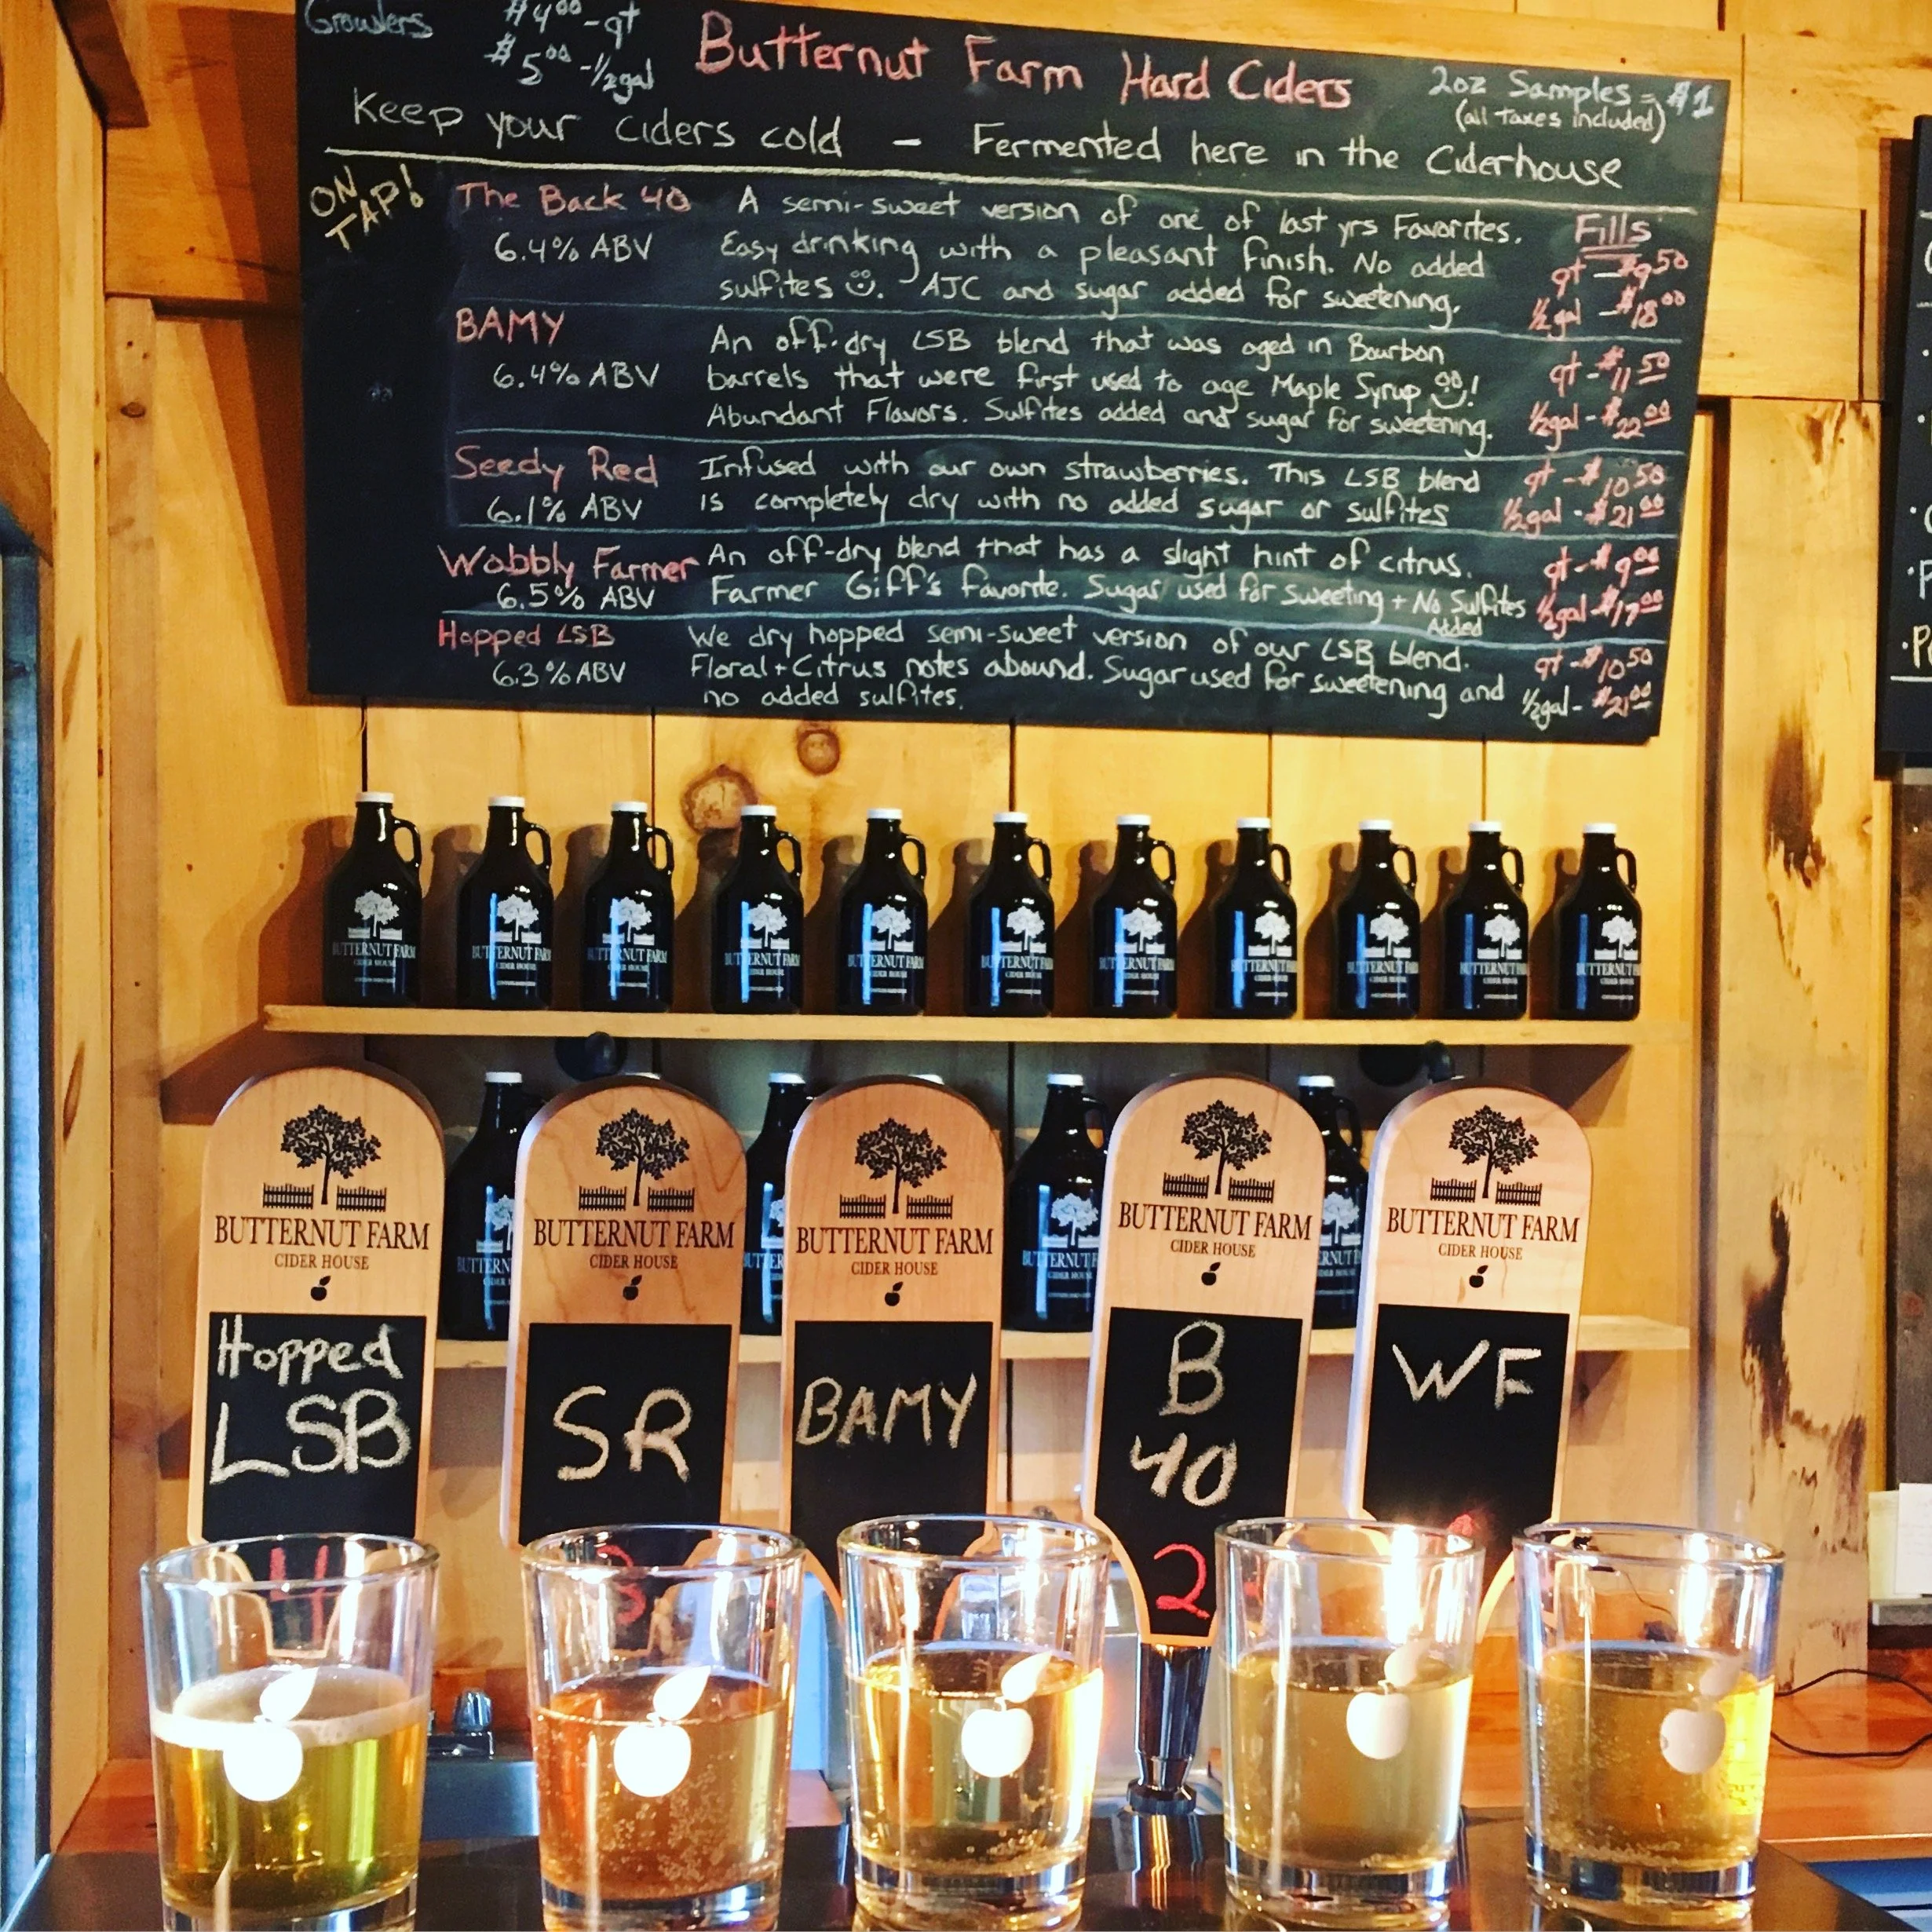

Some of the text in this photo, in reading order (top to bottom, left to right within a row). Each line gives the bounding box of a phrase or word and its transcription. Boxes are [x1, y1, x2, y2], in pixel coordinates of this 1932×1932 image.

[305, 0, 433, 38] Growlers
[696, 11, 1352, 108] Butternut Farm Hard Ciders
[1429, 66, 1485, 95] 2oz
[1510, 70, 1631, 114] Samples
[354, 88, 463, 136] Keep
[487, 111, 576, 149] your
[761, 116, 842, 157] cold
[974, 121, 1161, 162] Fermented
[1192, 130, 1268, 164] here
[1296, 148, 1324, 166] in
[1339, 135, 1398, 169] the
[1426, 141, 1622, 188] Ciderhouse
[1455, 99, 1488, 132] (all
[1573, 93, 1666, 144] included)
[311, 166, 357, 217] ON
[321, 163, 423, 250] TAP!
[457, 182, 691, 215] The Back 40
[739, 185, 758, 214] A
[982, 203, 1079, 223] version
[1101, 194, 1138, 225] of
[1160, 214, 1203, 230] one
[1225, 200, 1260, 231] of
[1280, 207, 1328, 234] last
[1339, 220, 1378, 247] yrs
[1394, 210, 1521, 243] Favorites.
[1576, 213, 1651, 244] Fills
[495, 232, 652, 262] 6.4% ABV
[721, 231, 777, 264] Easy
[793, 228, 919, 283] drinking
[940, 234, 1011, 261] with
[1038, 245, 1057, 258] a
[1080, 234, 1218, 275] pleasant
[1354, 250, 1391, 274] No
[1411, 250, 1485, 278] added
[456, 307, 564, 344] BAMY
[710, 325, 752, 354] An
[913, 328, 971, 351] LSB
[997, 327, 1069, 355] blend
[1091, 326, 1153, 352] that
[1168, 337, 1221, 354] was
[1242, 333, 1295, 371] aged
[1309, 338, 1331, 355] in
[1349, 333, 1444, 364] Bourbon
[494, 362, 659, 389] 6.4% ABV
[707, 363, 809, 390] barrels
[835, 360, 904, 389] that
[919, 367, 994, 388] were
[1092, 366, 1141, 391] used
[1155, 369, 1182, 392] to
[1198, 380, 1254, 418] age
[1272, 374, 1341, 409] Maple
[1355, 372, 1421, 414] Syrup
[451, 446, 658, 492] Seedy Red
[699, 446, 1479, 493] Infused with our own strawberries. This LSB blend
[488, 492, 641, 528] 6.1% ABV
[701, 484, 1448, 535] is completely dry with no added sugar or sulfites
[438, 542, 699, 589] Wobbly Farmer
[708, 534, 1470, 579] An off-dry blend that has a slight hint of citrus.
[497, 583, 655, 609] 6.5% ABV
[439, 619, 615, 656] Hopped LSB
[688, 615, 1468, 672] We dry hopped semi-sweet version of our LSB blend.
[493, 661, 625, 687] 6.3% ABV
[214, 1215, 430, 1250] BUTTERNUT FARM
[533, 1218, 735, 1249] BUTTERNUT FARM
[796, 1226, 993, 1255] BUTTERNUT FARM
[1118, 1201, 1312, 1241] BUTTERNUT FARM
[1386, 1207, 1580, 1244] BUTTERNUT FARM
[274, 1253, 369, 1270] CIDER HOUSE
[590, 1255, 678, 1269] CIDER HOUSE
[851, 1262, 938, 1276] CIDER HOUSE
[1170, 1239, 1255, 1258] CIDER HOUSE
[1438, 1243, 1523, 1260] CIDER HOUSE
[217, 1314, 404, 1387] Hopped
[1159, 1319, 1225, 1416] B
[794, 1371, 977, 1449] BAMY
[210, 1387, 411, 1485] LSB
[1130, 1432, 1237, 1507] 40
[1153, 1543, 1211, 1620] 2
